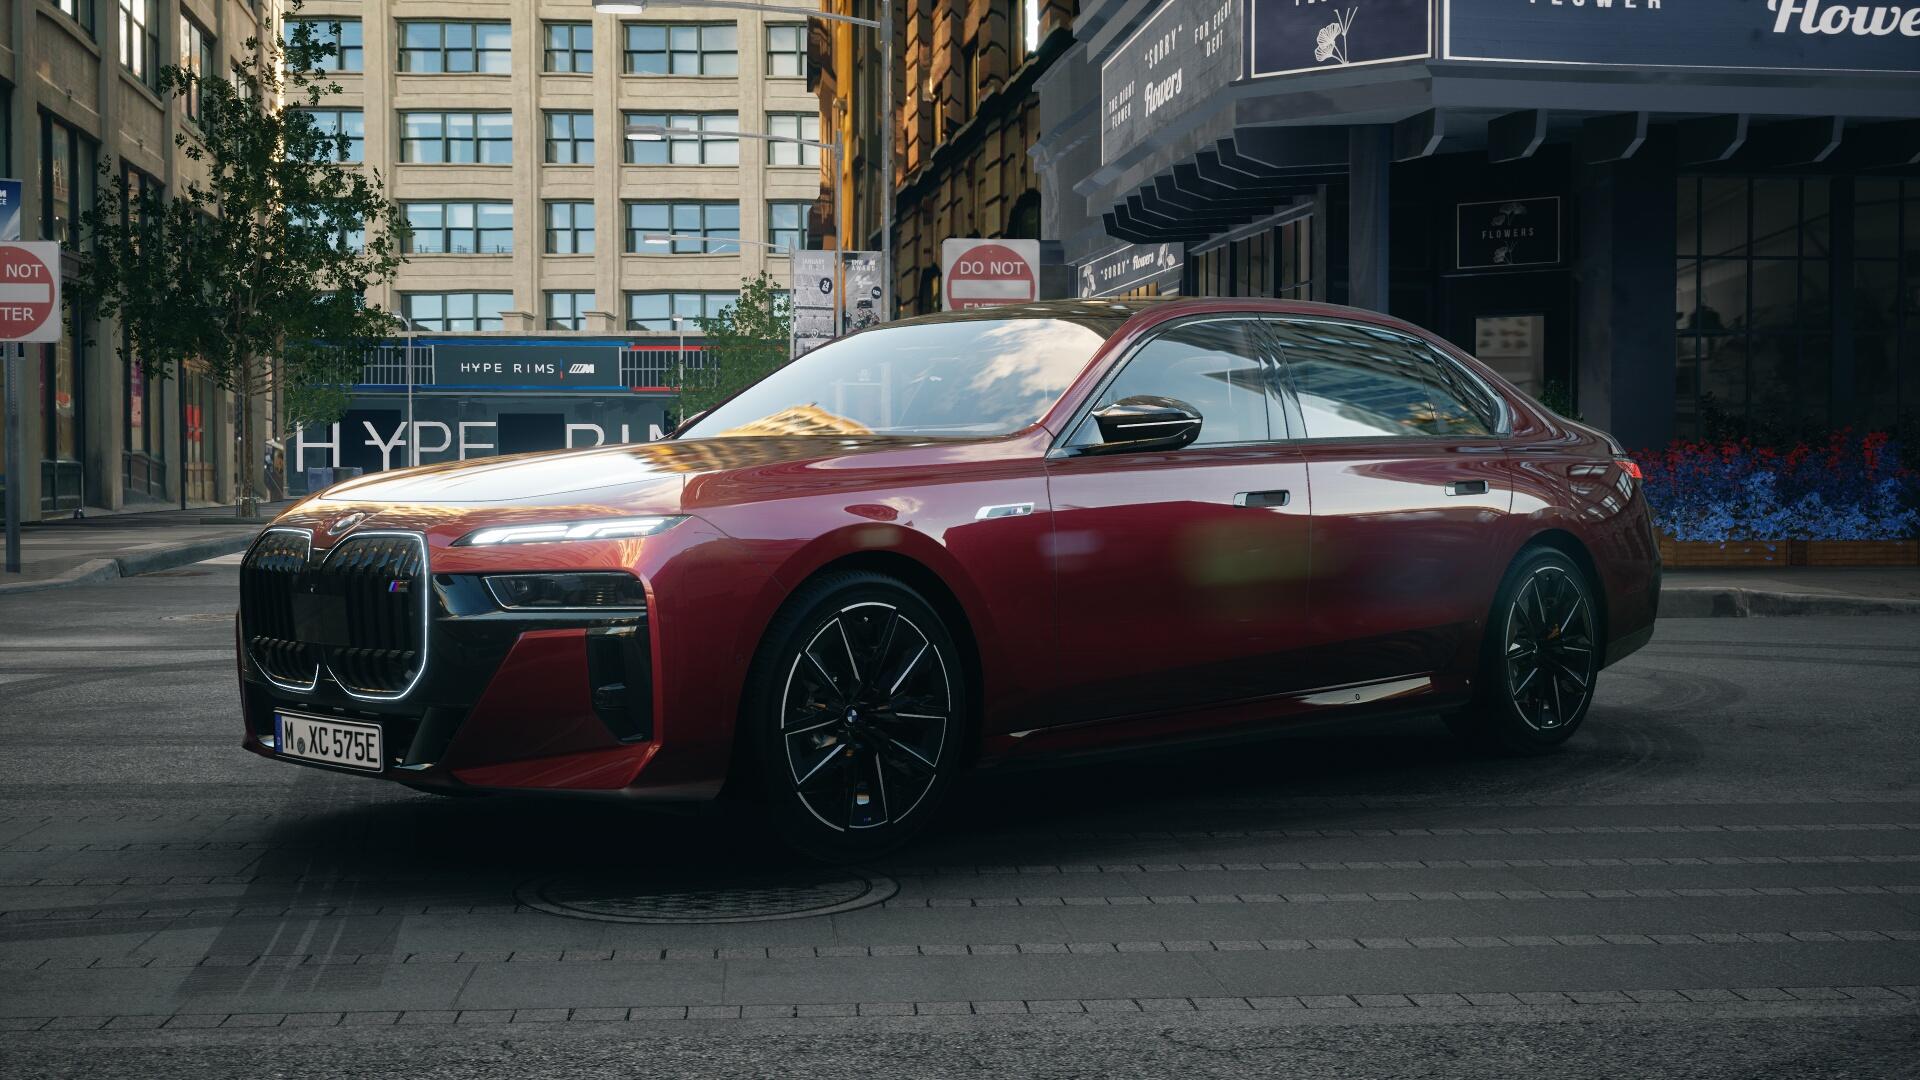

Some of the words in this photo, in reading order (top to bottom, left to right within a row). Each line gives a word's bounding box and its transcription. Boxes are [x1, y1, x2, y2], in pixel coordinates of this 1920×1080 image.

[1194, 21, 1209, 44] FOR
[1109, 96, 1118, 115] THE
[1120, 80, 1135, 105] RIGHT
[1112, 103, 1131, 130] FLOWER
[1482, 227, 1534, 240] FLOWERS
[6, 264, 43, 278] NOT
[961, 261, 984, 275] DO
[990, 261, 1024, 275] NOT
[0, 307, 34, 321] TER
[461, 363, 503, 373] HYPE
[513, 363, 555, 374] RIMS
[284, 720, 294, 750] M
[309, 725, 329, 756] XC
[333, 728, 378, 763] 575E
